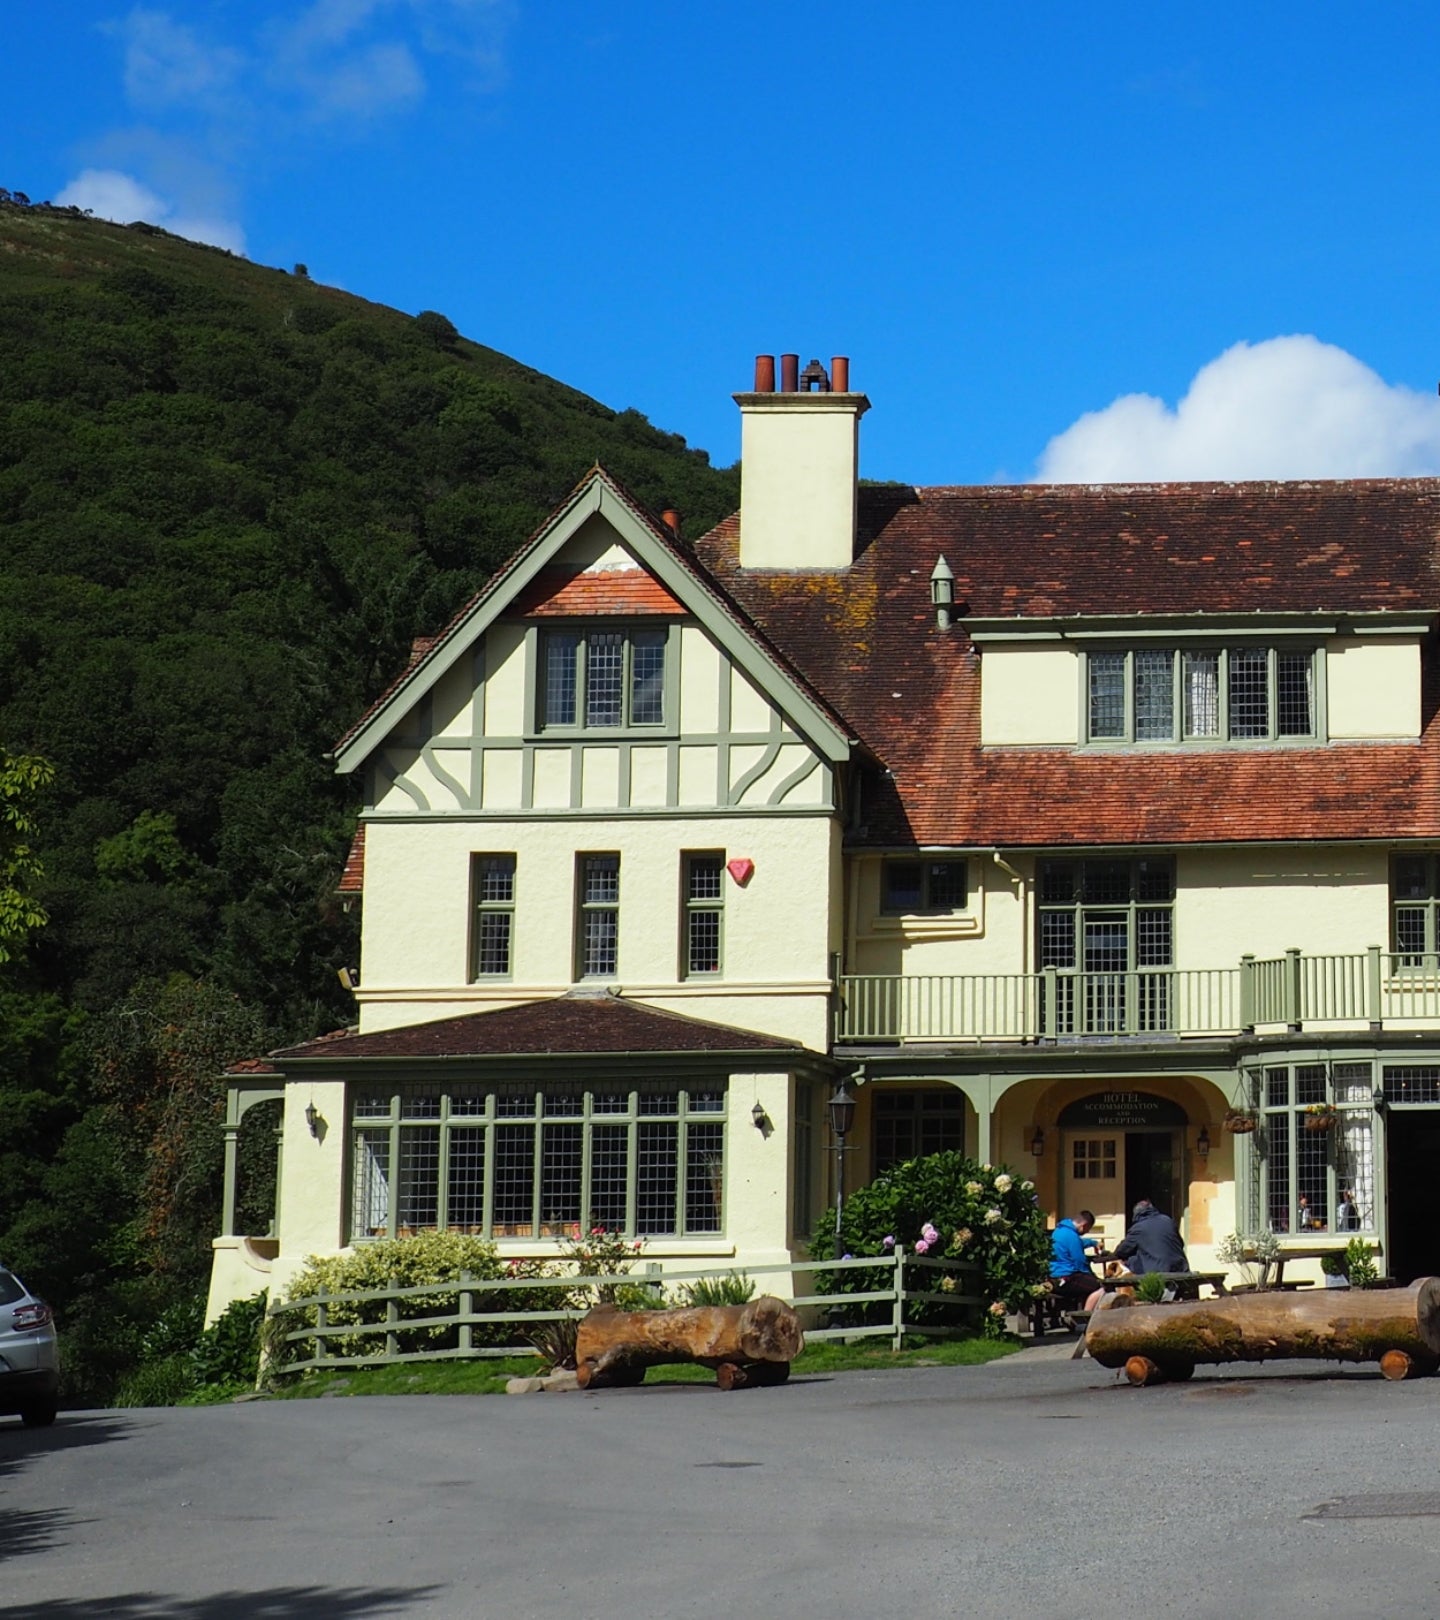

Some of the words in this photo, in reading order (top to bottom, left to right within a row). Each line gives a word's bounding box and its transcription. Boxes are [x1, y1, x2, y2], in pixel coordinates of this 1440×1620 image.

[1103, 1093, 1140, 1103] HOTEL
[1084, 1103, 1159, 1111] ACCOMMODATION
[1098, 1116, 1147, 1125] RECEPTION
